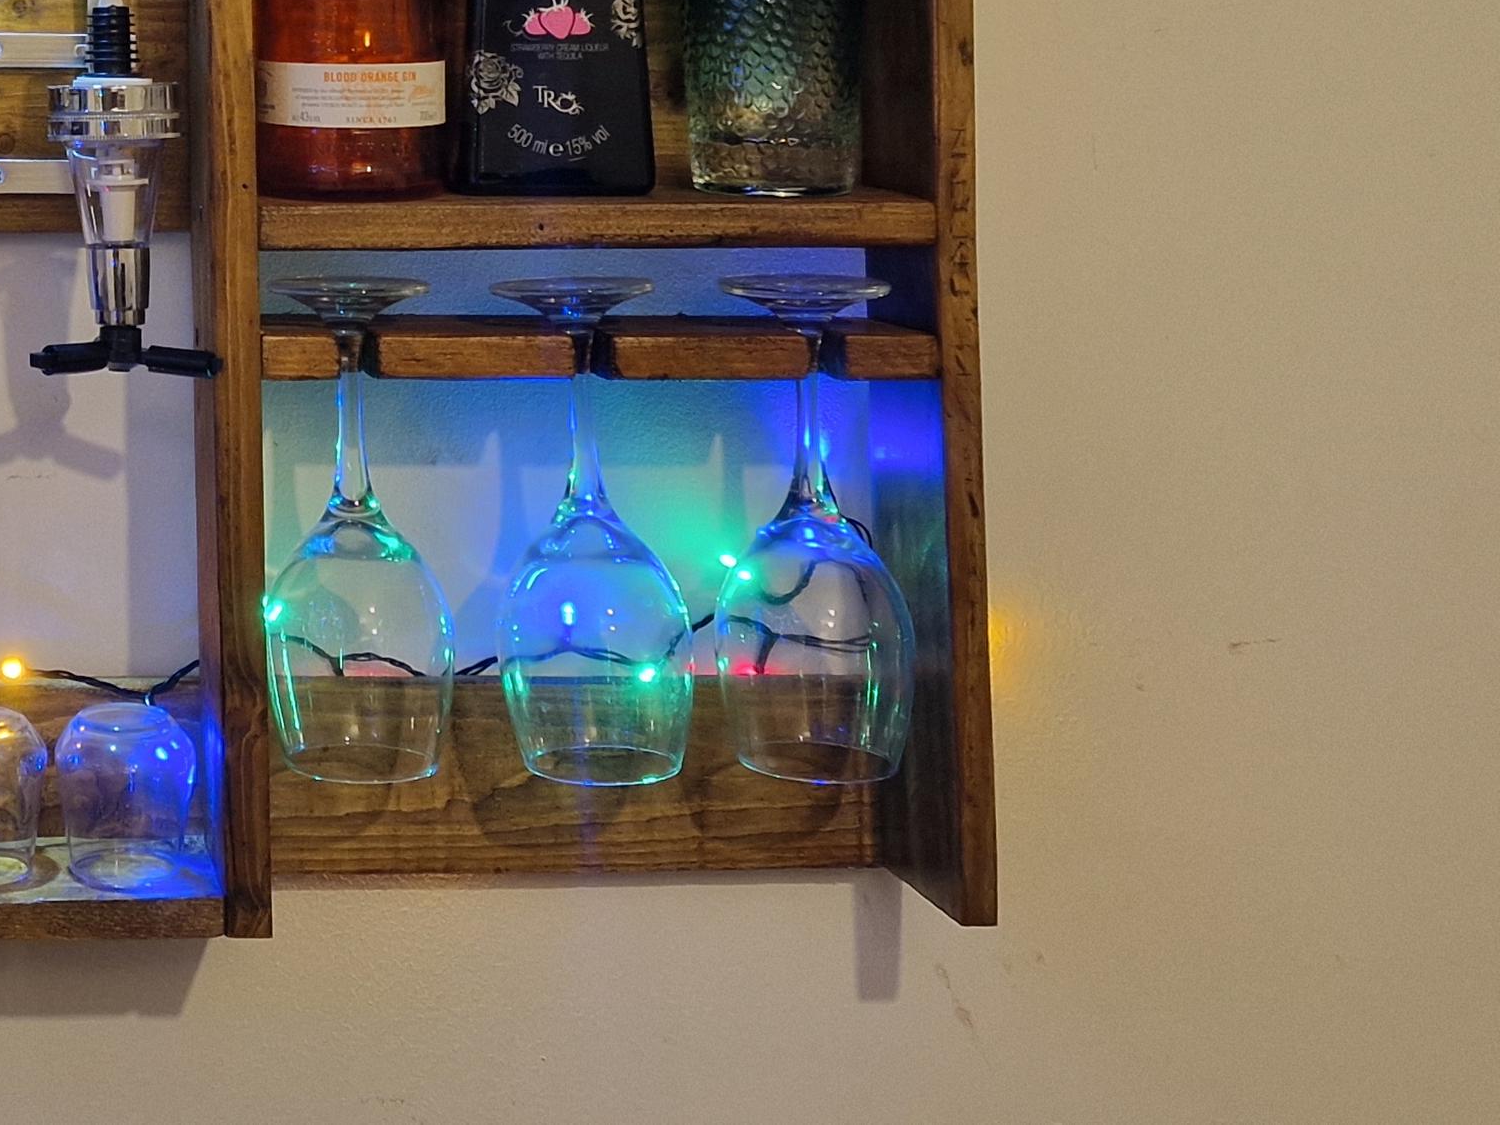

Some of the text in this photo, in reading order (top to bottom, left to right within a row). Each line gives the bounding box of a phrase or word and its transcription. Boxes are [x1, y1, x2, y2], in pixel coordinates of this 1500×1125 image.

[323, 70, 417, 83] BLOOD ORANGE GIN
[508, 124, 534, 148] 500
[532, 140, 549, 155] ml
[566, 136, 593, 156] 15%
[591, 124, 611, 145] vol
